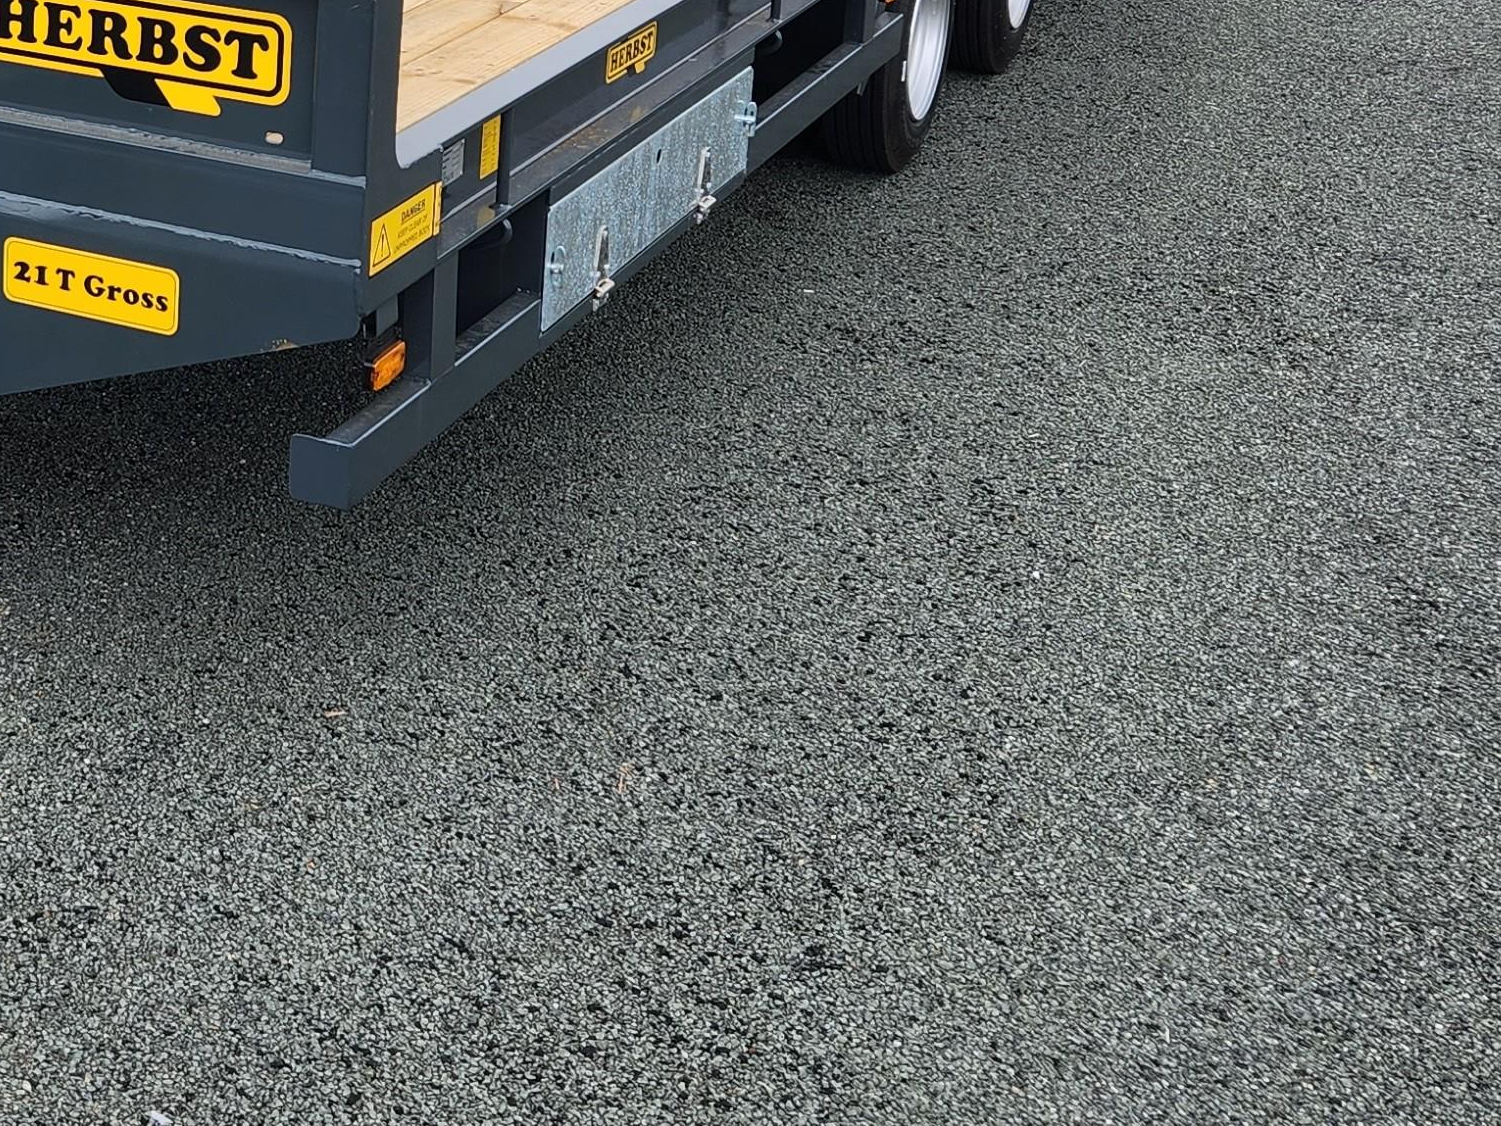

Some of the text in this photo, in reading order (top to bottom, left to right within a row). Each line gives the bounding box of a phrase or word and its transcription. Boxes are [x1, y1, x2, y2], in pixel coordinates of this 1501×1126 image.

[610, 30, 654, 74] HERBST
[401, 198, 426, 223] DANGER
[13, 261, 169, 312] 21 T Gross
